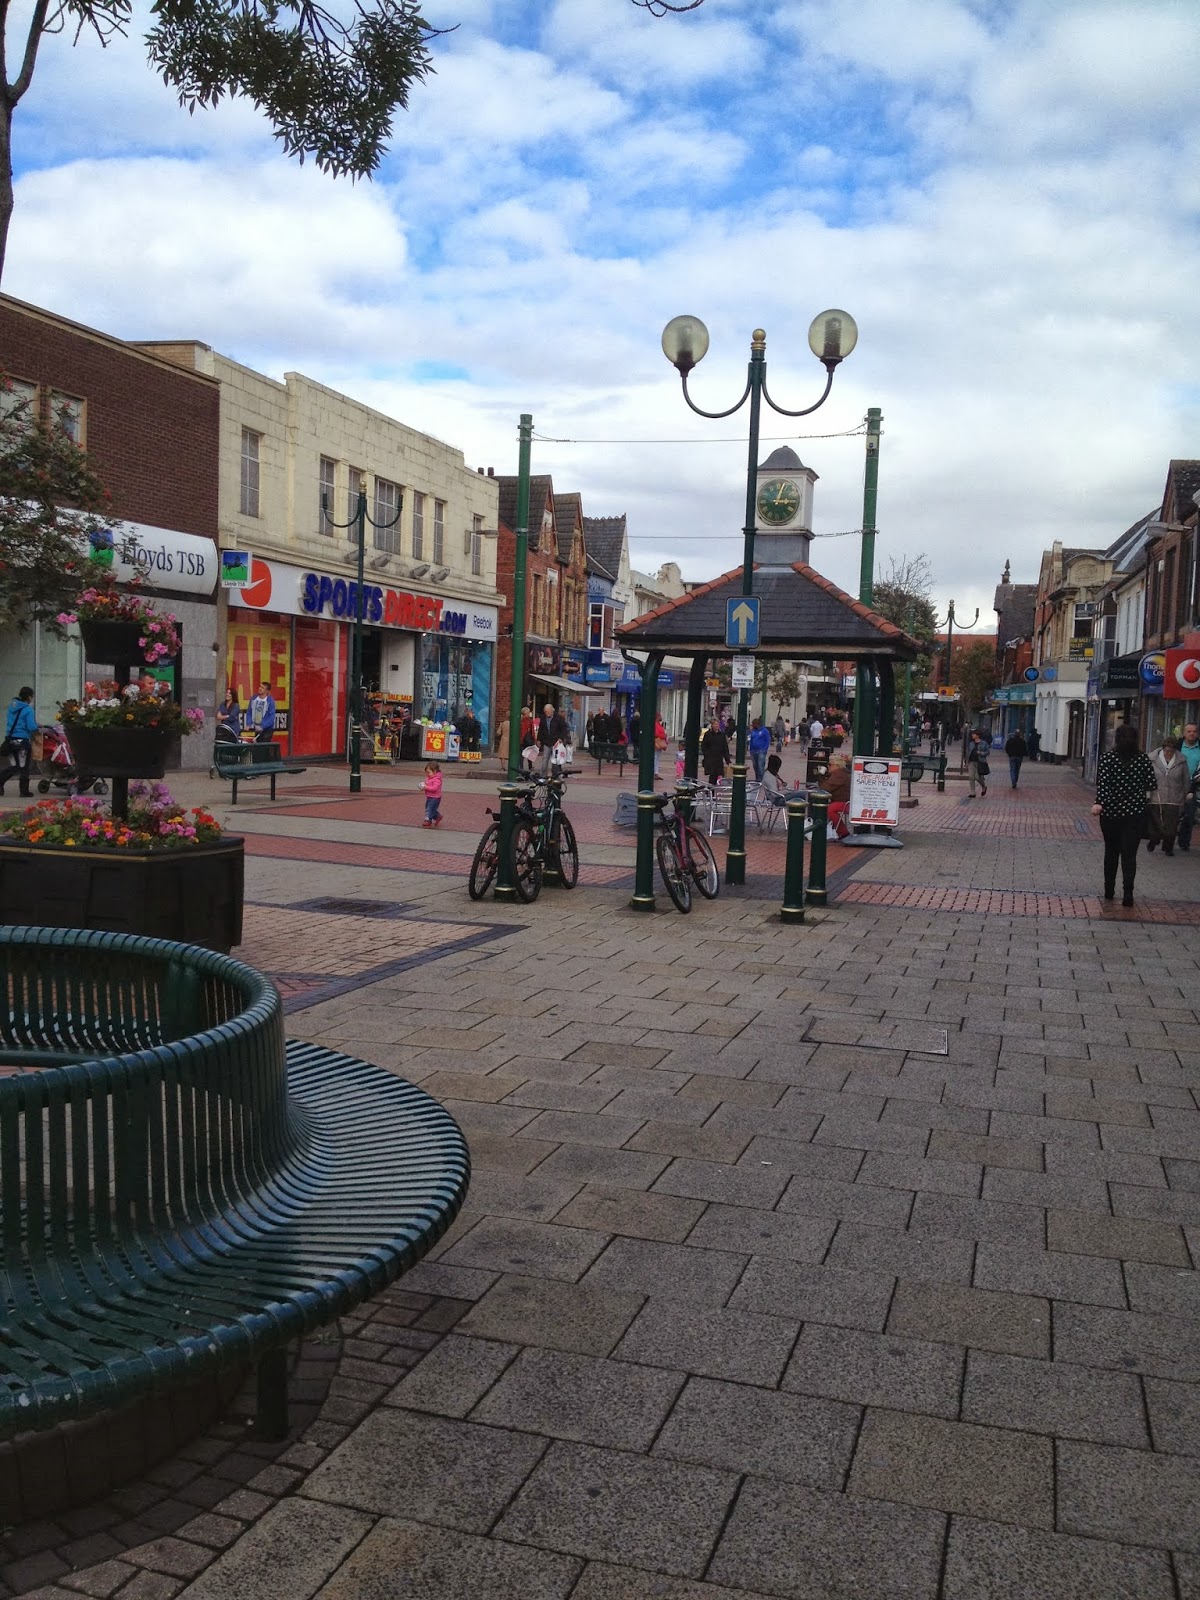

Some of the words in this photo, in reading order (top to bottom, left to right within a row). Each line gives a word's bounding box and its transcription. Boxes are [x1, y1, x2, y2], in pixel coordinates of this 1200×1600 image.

[176, 550, 205, 576] TSB
[473, 615, 492, 630] Reebok
[227, 635, 286, 701] ALE
[469, 752, 481, 760] SALE
